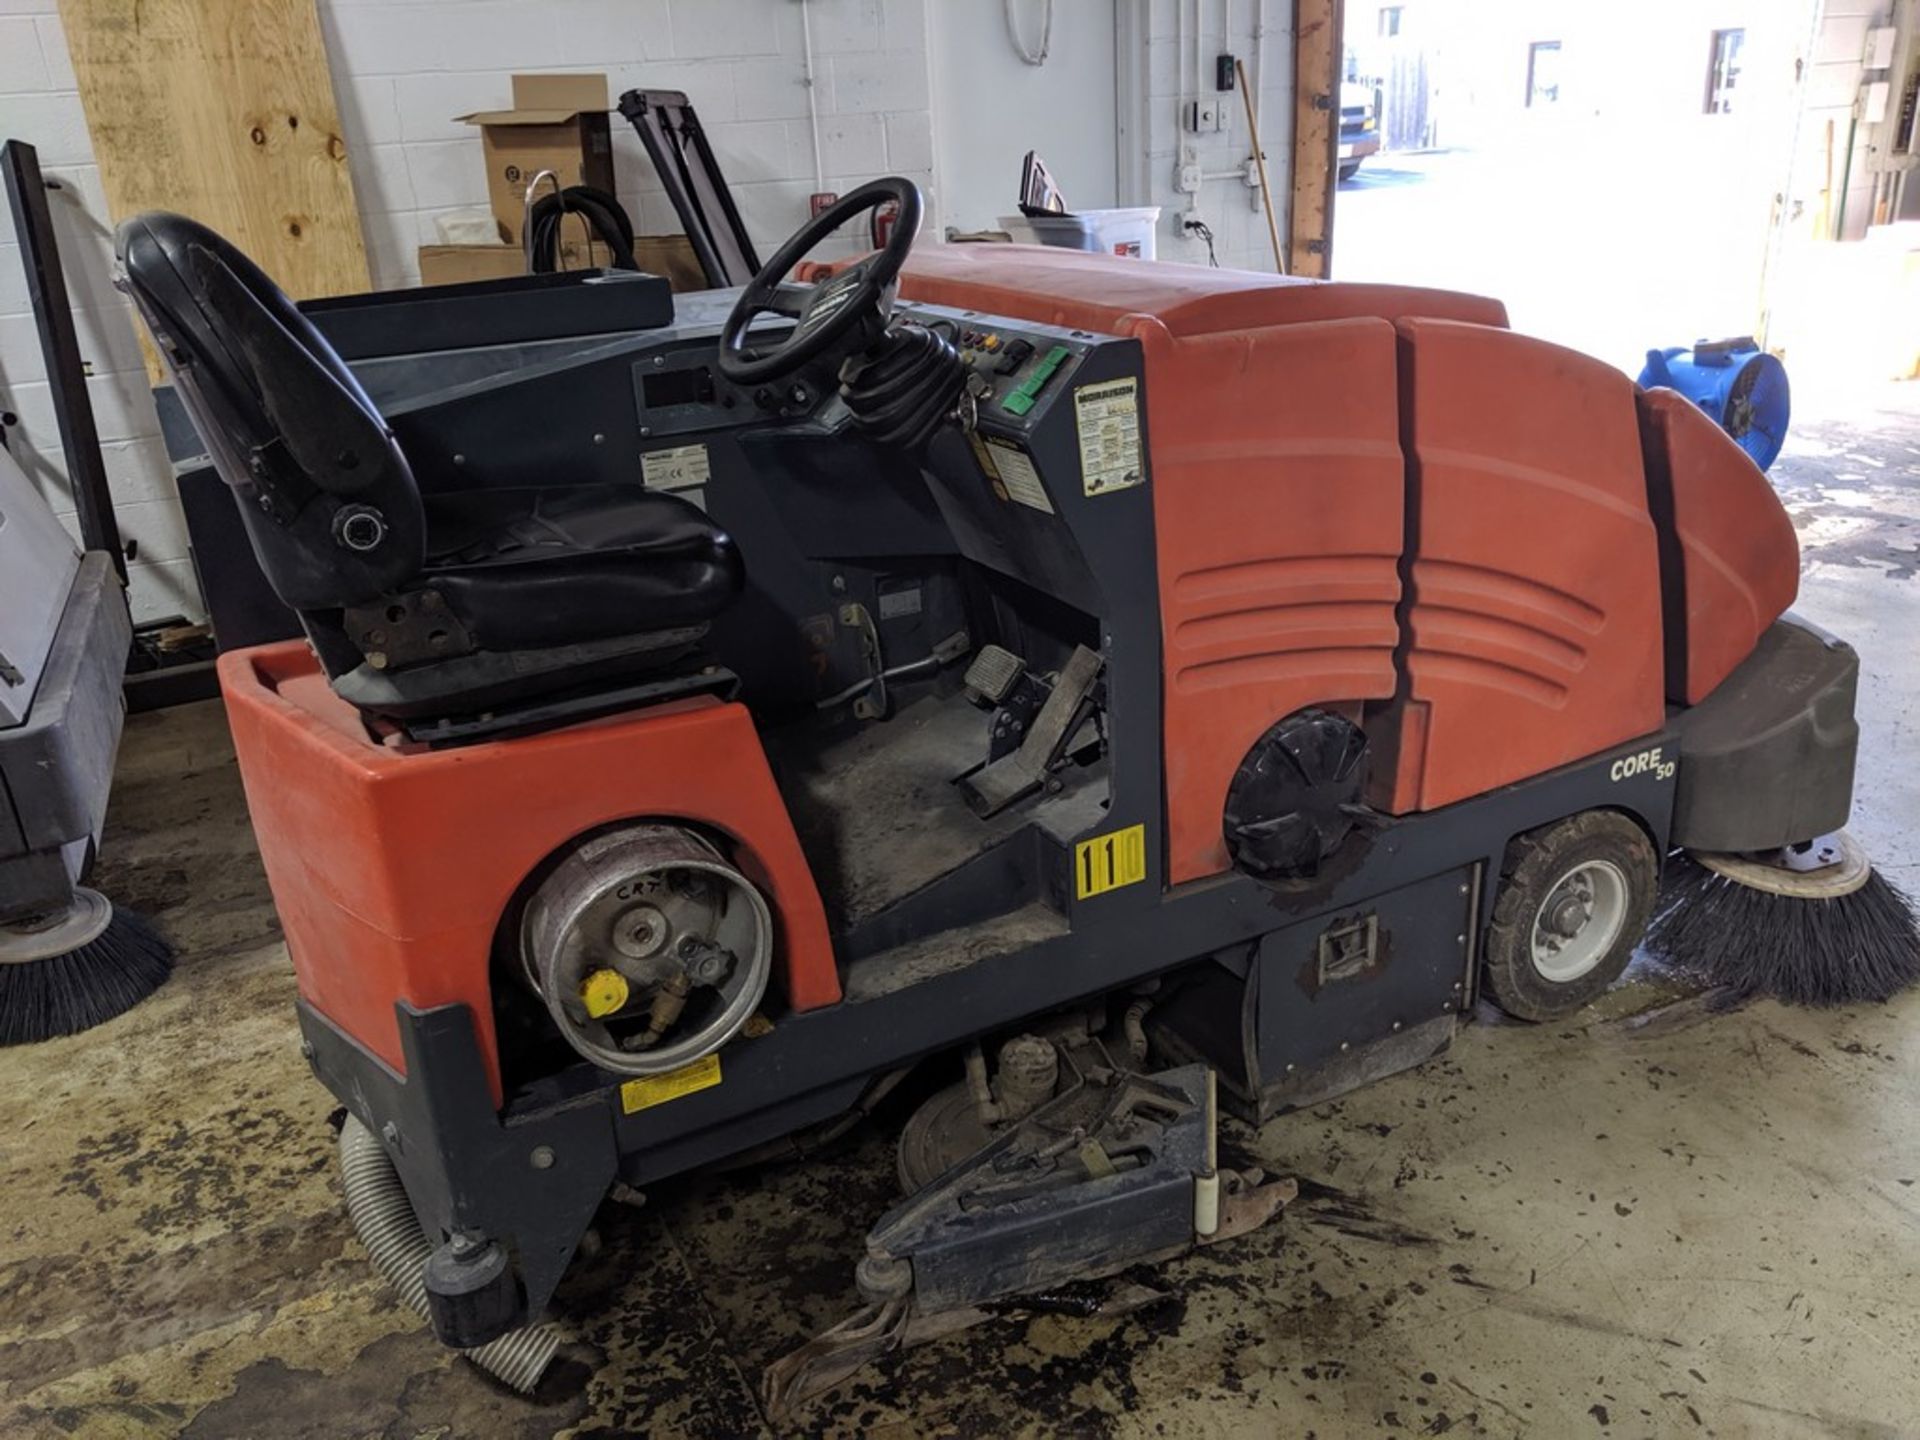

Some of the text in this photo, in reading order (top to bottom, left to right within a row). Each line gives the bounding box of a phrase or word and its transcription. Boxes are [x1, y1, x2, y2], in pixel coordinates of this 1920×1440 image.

[1078, 385, 1133, 404] MORRISON
[1611, 747, 1675, 782] CORE 50
